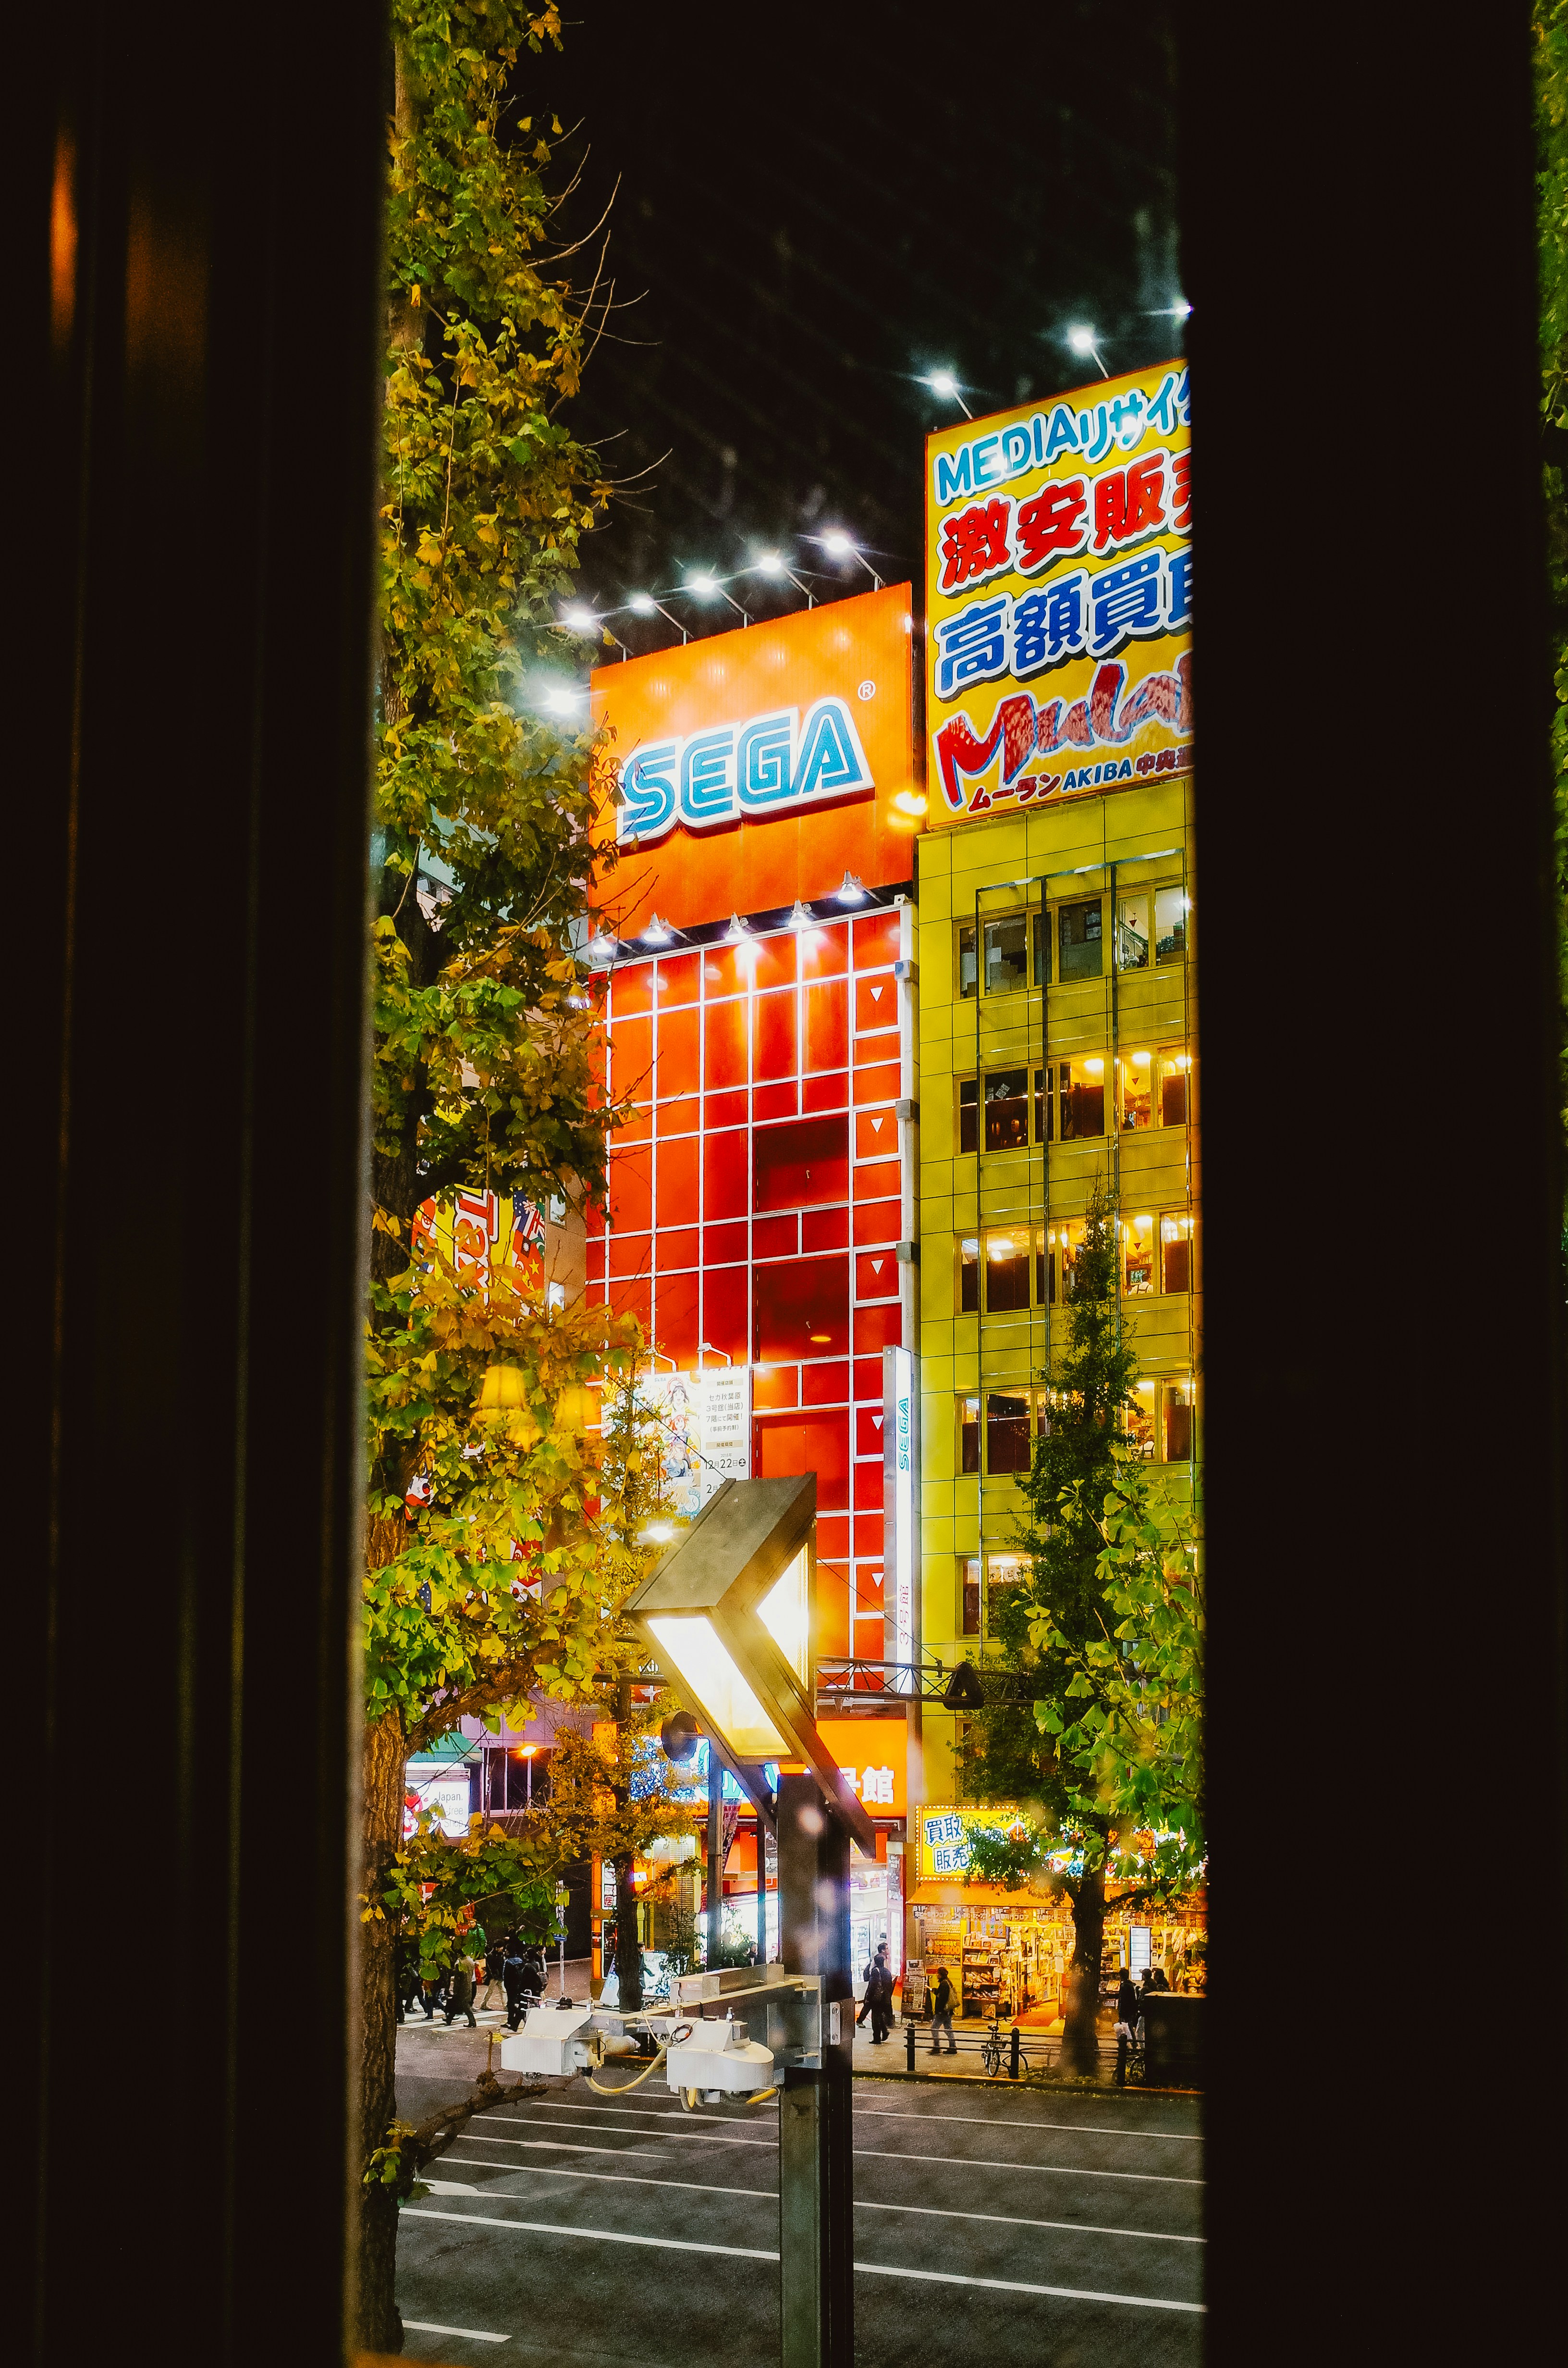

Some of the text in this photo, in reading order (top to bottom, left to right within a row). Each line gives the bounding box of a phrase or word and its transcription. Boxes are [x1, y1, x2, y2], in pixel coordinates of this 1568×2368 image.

[937, 372, 1191, 501] MEDIAリサイ
[941, 452, 1192, 590] 激安販
[617, 697, 875, 846] SEGA
[1063, 758, 1132, 791] AKIBA
[898, 1397, 909, 1472] SEGA
[706, 1483, 723, 1493] 2月
[899, 1584, 909, 1645] 3号館
[436, 1791, 464, 1803] Japan.
[444, 1820, 464, 1830] Shop
[927, 1816, 962, 1844] 買取
